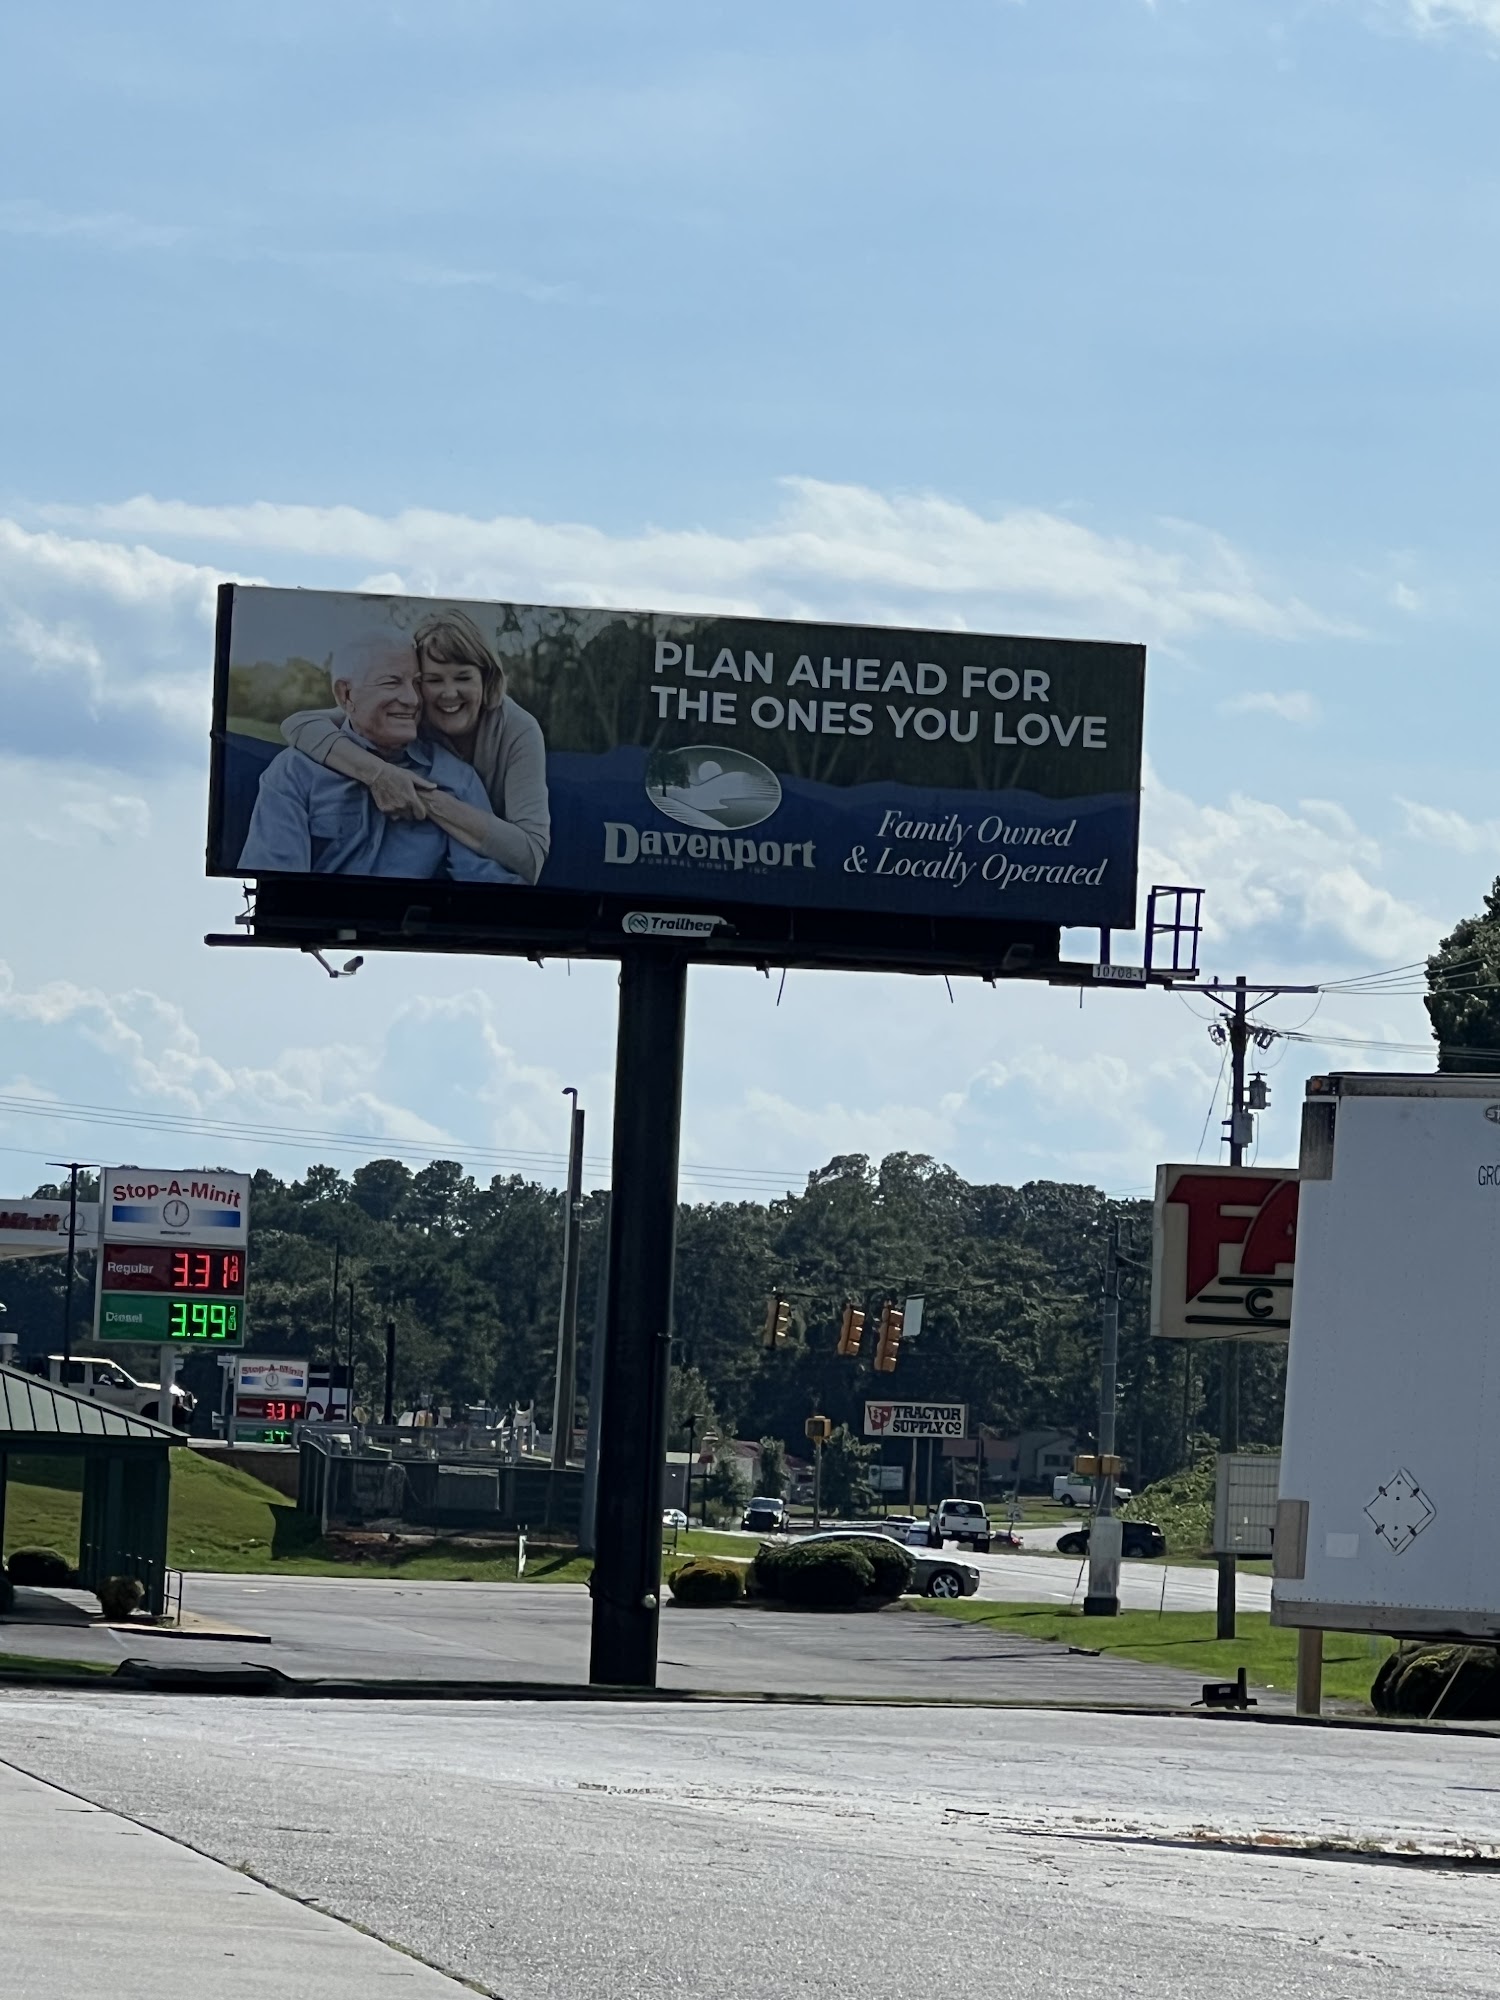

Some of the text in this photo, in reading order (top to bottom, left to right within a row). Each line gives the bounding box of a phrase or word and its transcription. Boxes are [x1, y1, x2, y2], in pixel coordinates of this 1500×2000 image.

[654, 641, 1050, 702] PLAN AHEAD FOR
[650, 685, 1107, 748] THE ONES YOU LOVE
[876, 809, 1077, 851] Family Owned
[603, 821, 817, 870] Davenport
[843, 845, 1109, 890] & Locally Operated
[651, 916, 720, 932] Trailhea
[112, 1180, 241, 1208] Stop-A-Minit
[107, 1261, 154, 1276] Regular
[105, 1311, 143, 1323] Diesel
[892, 1420, 944, 1434] SUPPLY
[893, 1405, 961, 1421] TRACTOR
